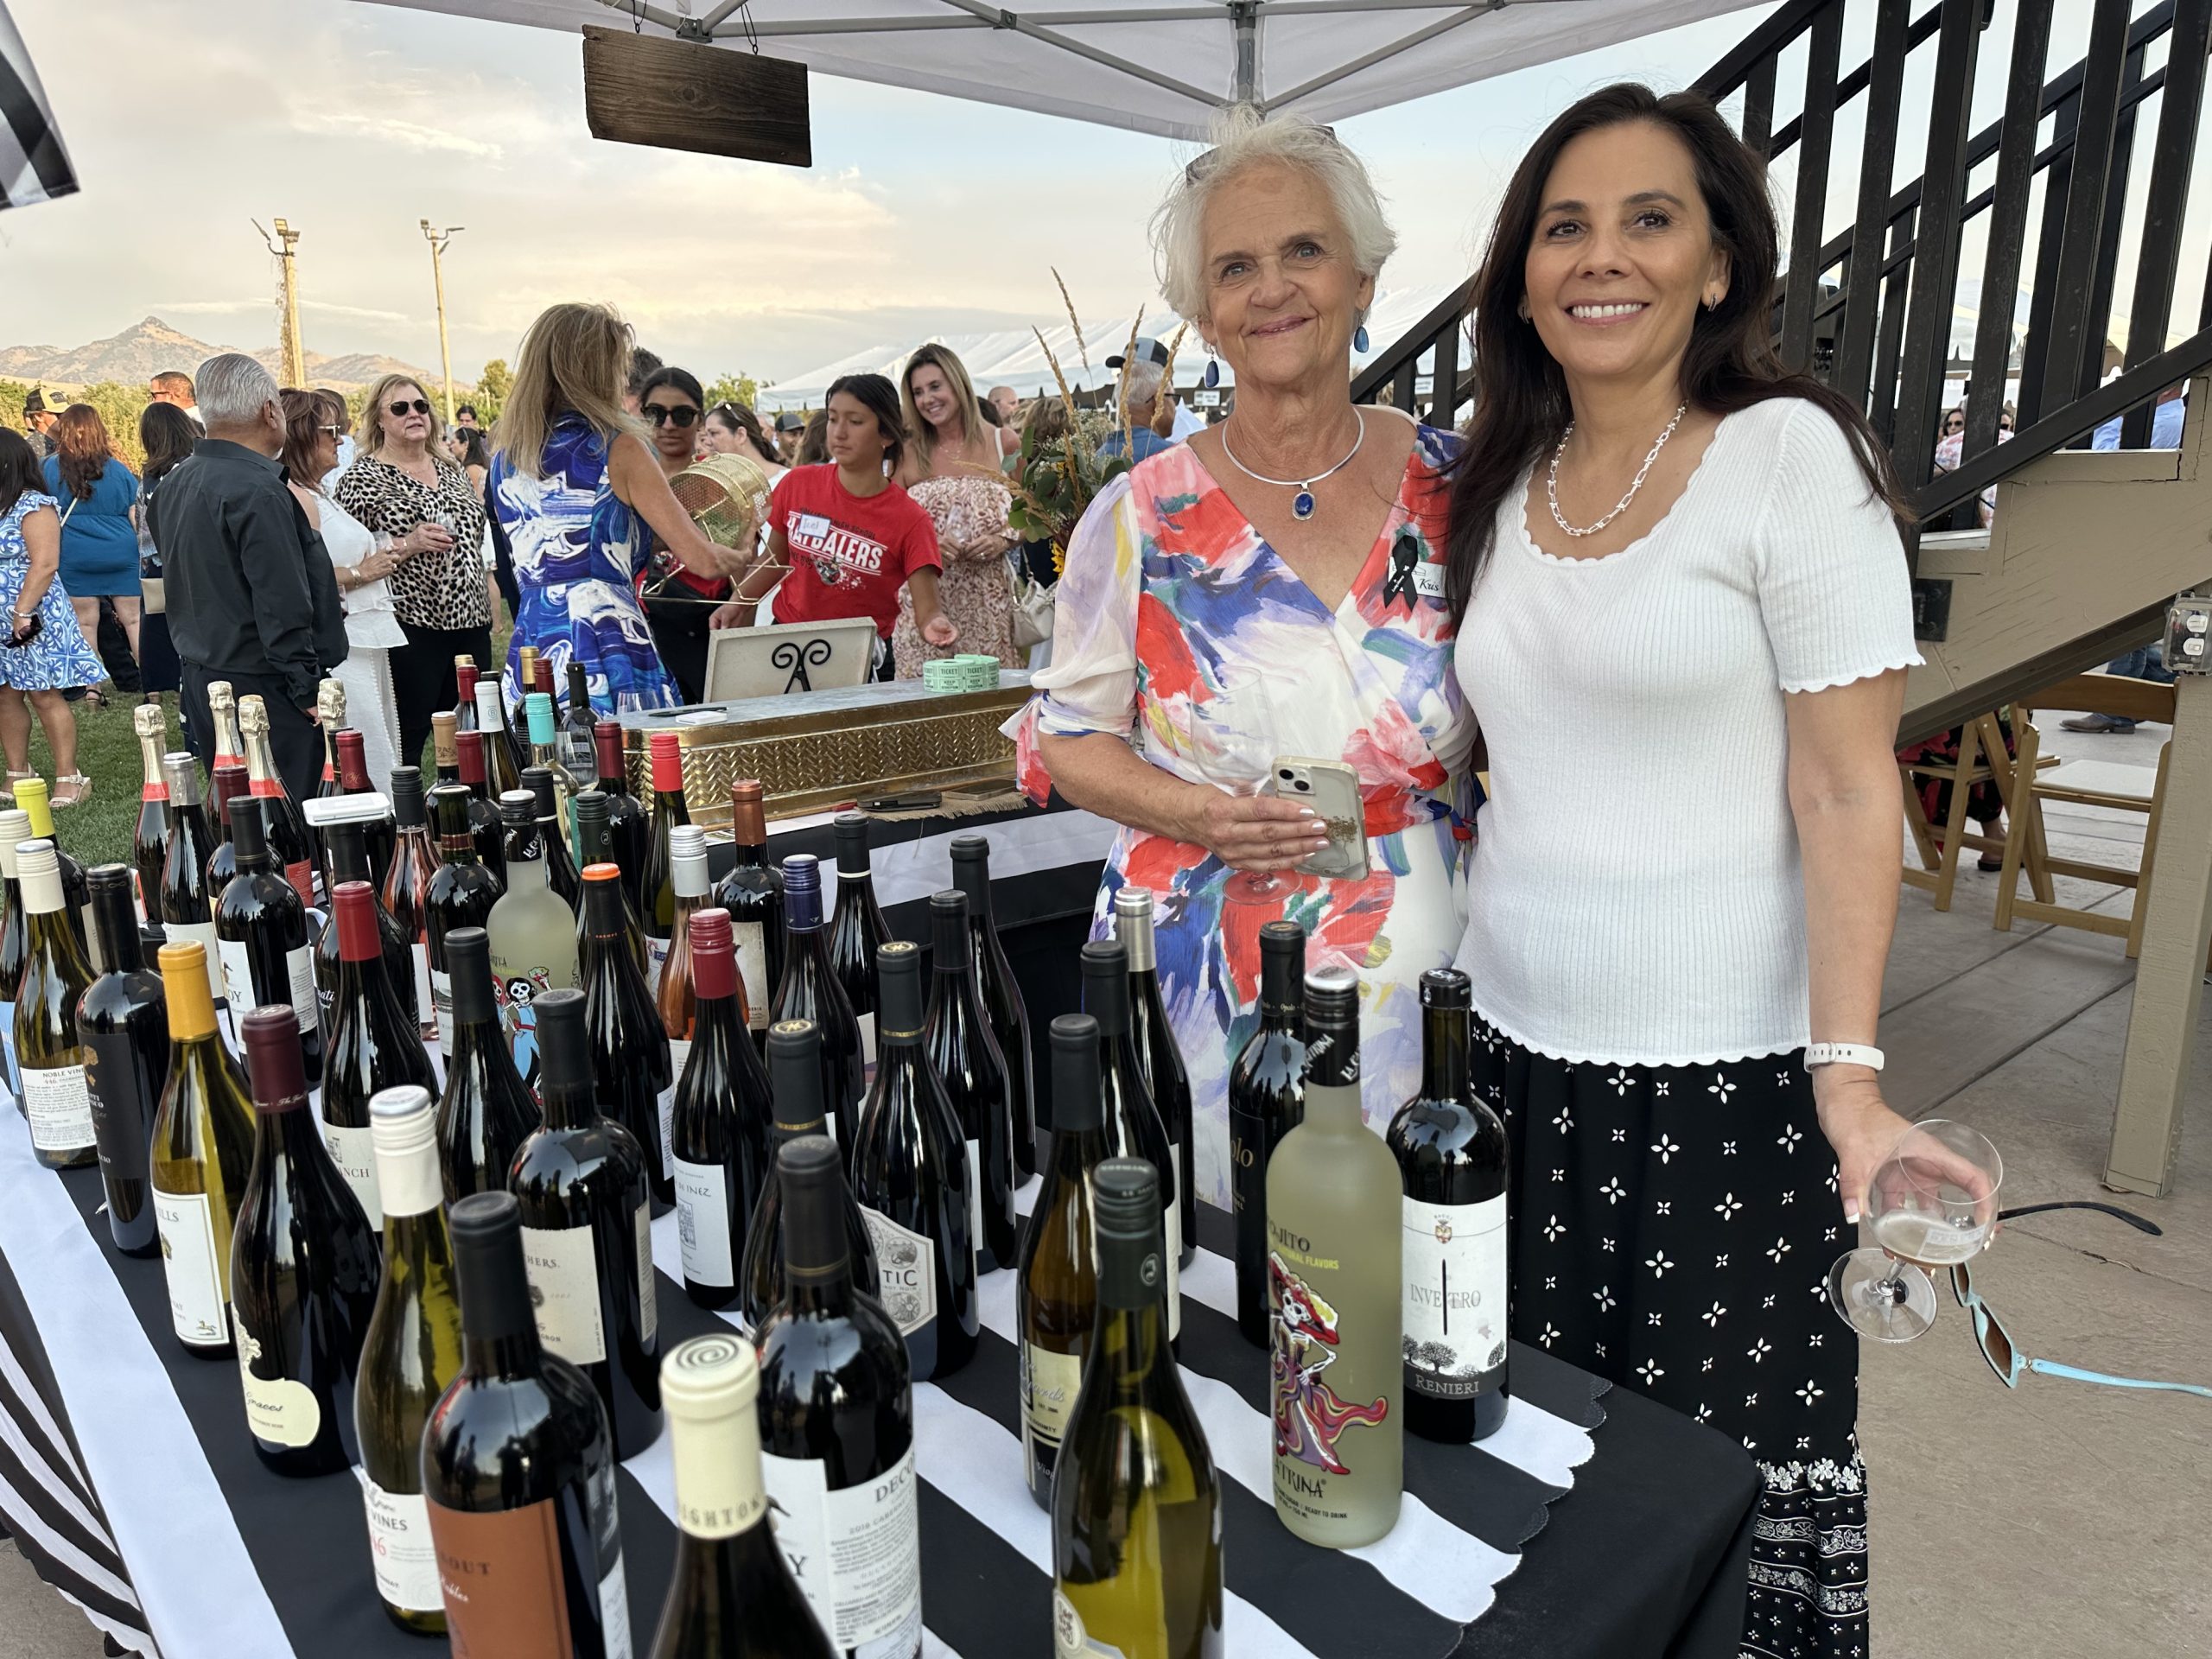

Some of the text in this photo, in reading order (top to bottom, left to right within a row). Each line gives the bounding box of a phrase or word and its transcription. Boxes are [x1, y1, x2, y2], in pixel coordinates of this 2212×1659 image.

[686, 1184, 711, 1198] INEZ
[1306, 1255, 1340, 1270] FLAVORS
[1415, 1374, 1479, 1395] RENIERI
[1304, 1505, 1321, 1516] READY
